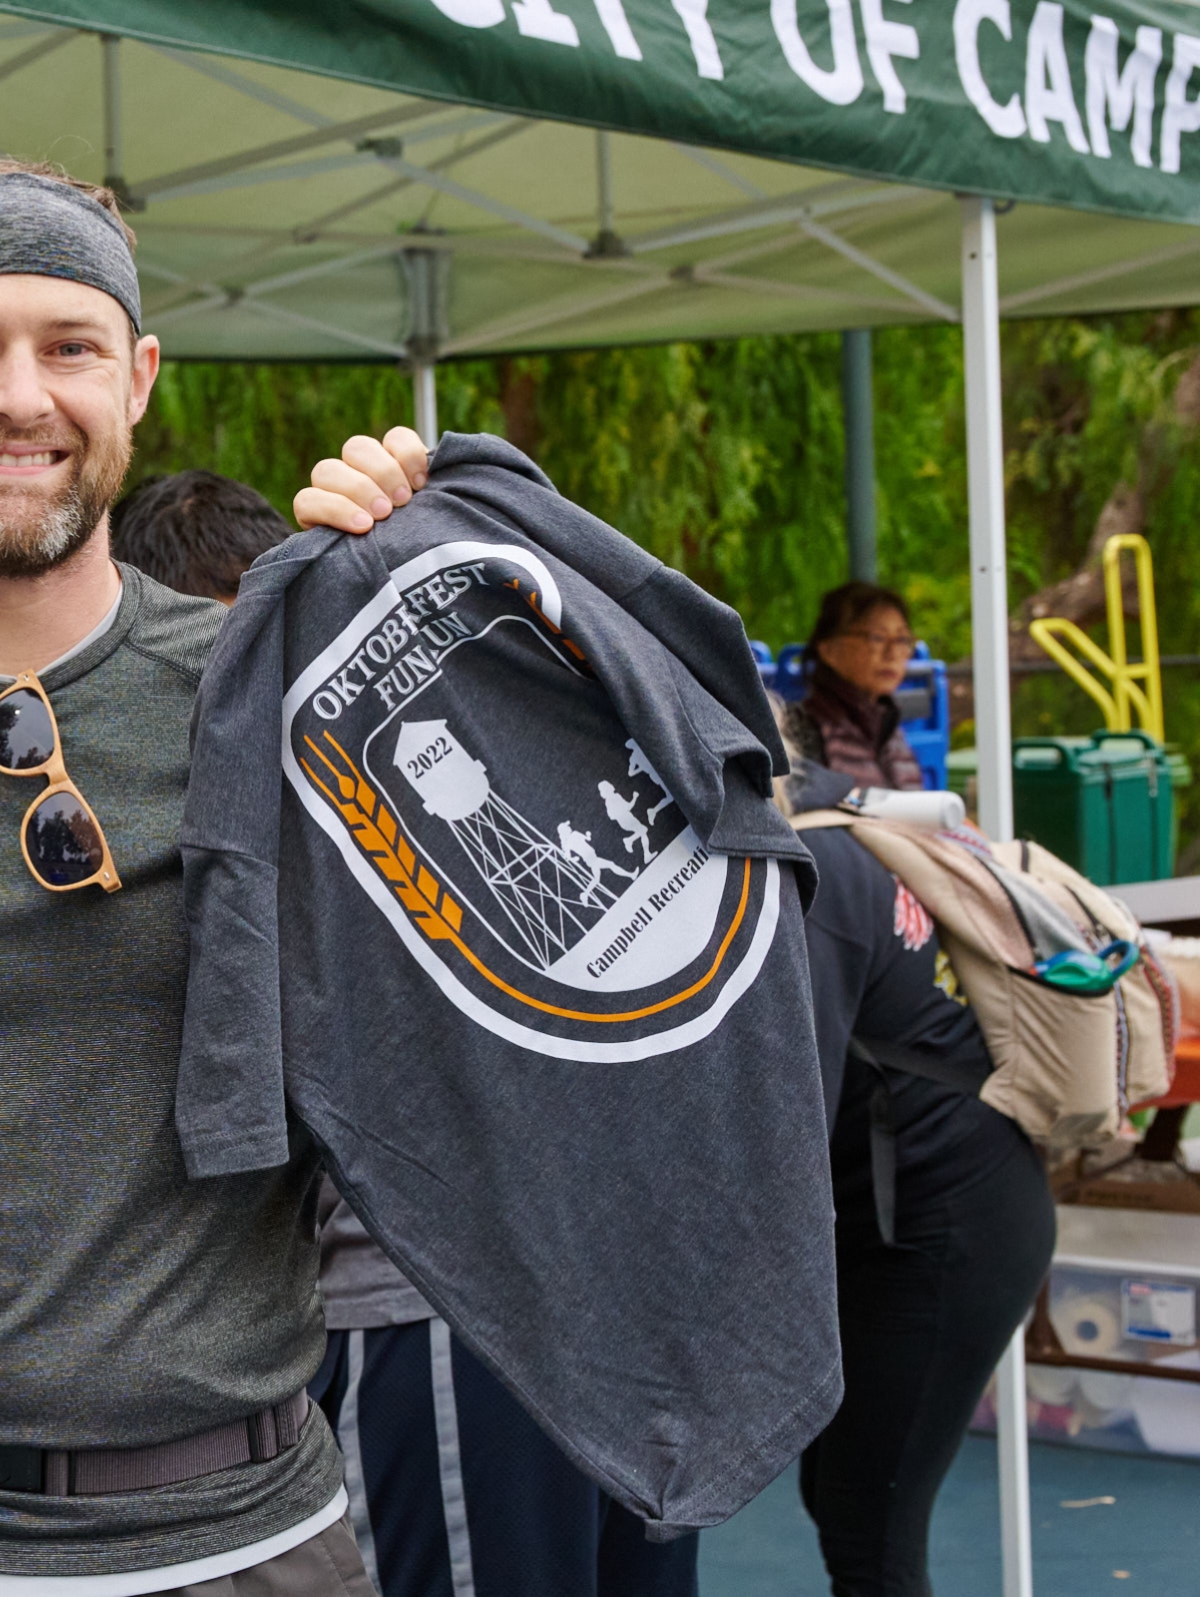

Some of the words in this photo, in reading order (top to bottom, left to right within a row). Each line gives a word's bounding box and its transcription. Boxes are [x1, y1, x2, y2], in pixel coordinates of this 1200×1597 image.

[769, 0, 920, 114] OF
[312, 562, 490, 720] OKTOBFEST
[373, 644, 437, 712] FUN
[420, 611, 473, 661] UN
[406, 736, 453, 779] 2022
[585, 906, 653, 979] Campbell
